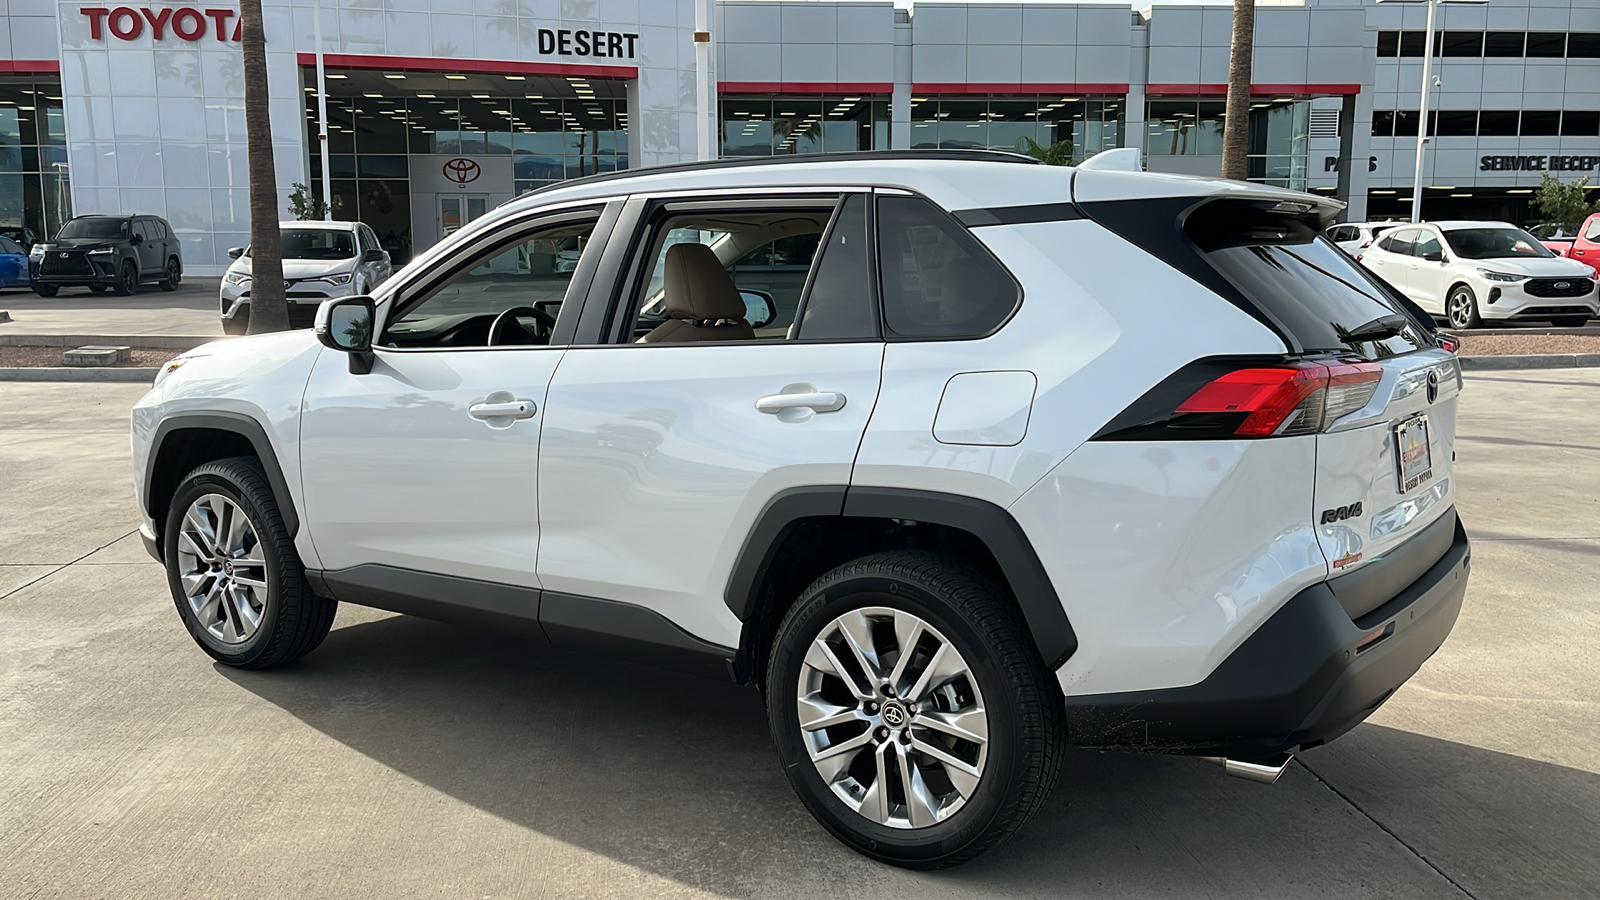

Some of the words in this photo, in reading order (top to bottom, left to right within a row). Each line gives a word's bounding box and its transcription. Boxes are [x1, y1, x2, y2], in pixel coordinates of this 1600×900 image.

[80, 6, 242, 42] TOYOT
[538, 28, 639, 58] DESERT
[1480, 155, 1547, 171] SERVICE
[1320, 501, 1363, 525] RAV4
